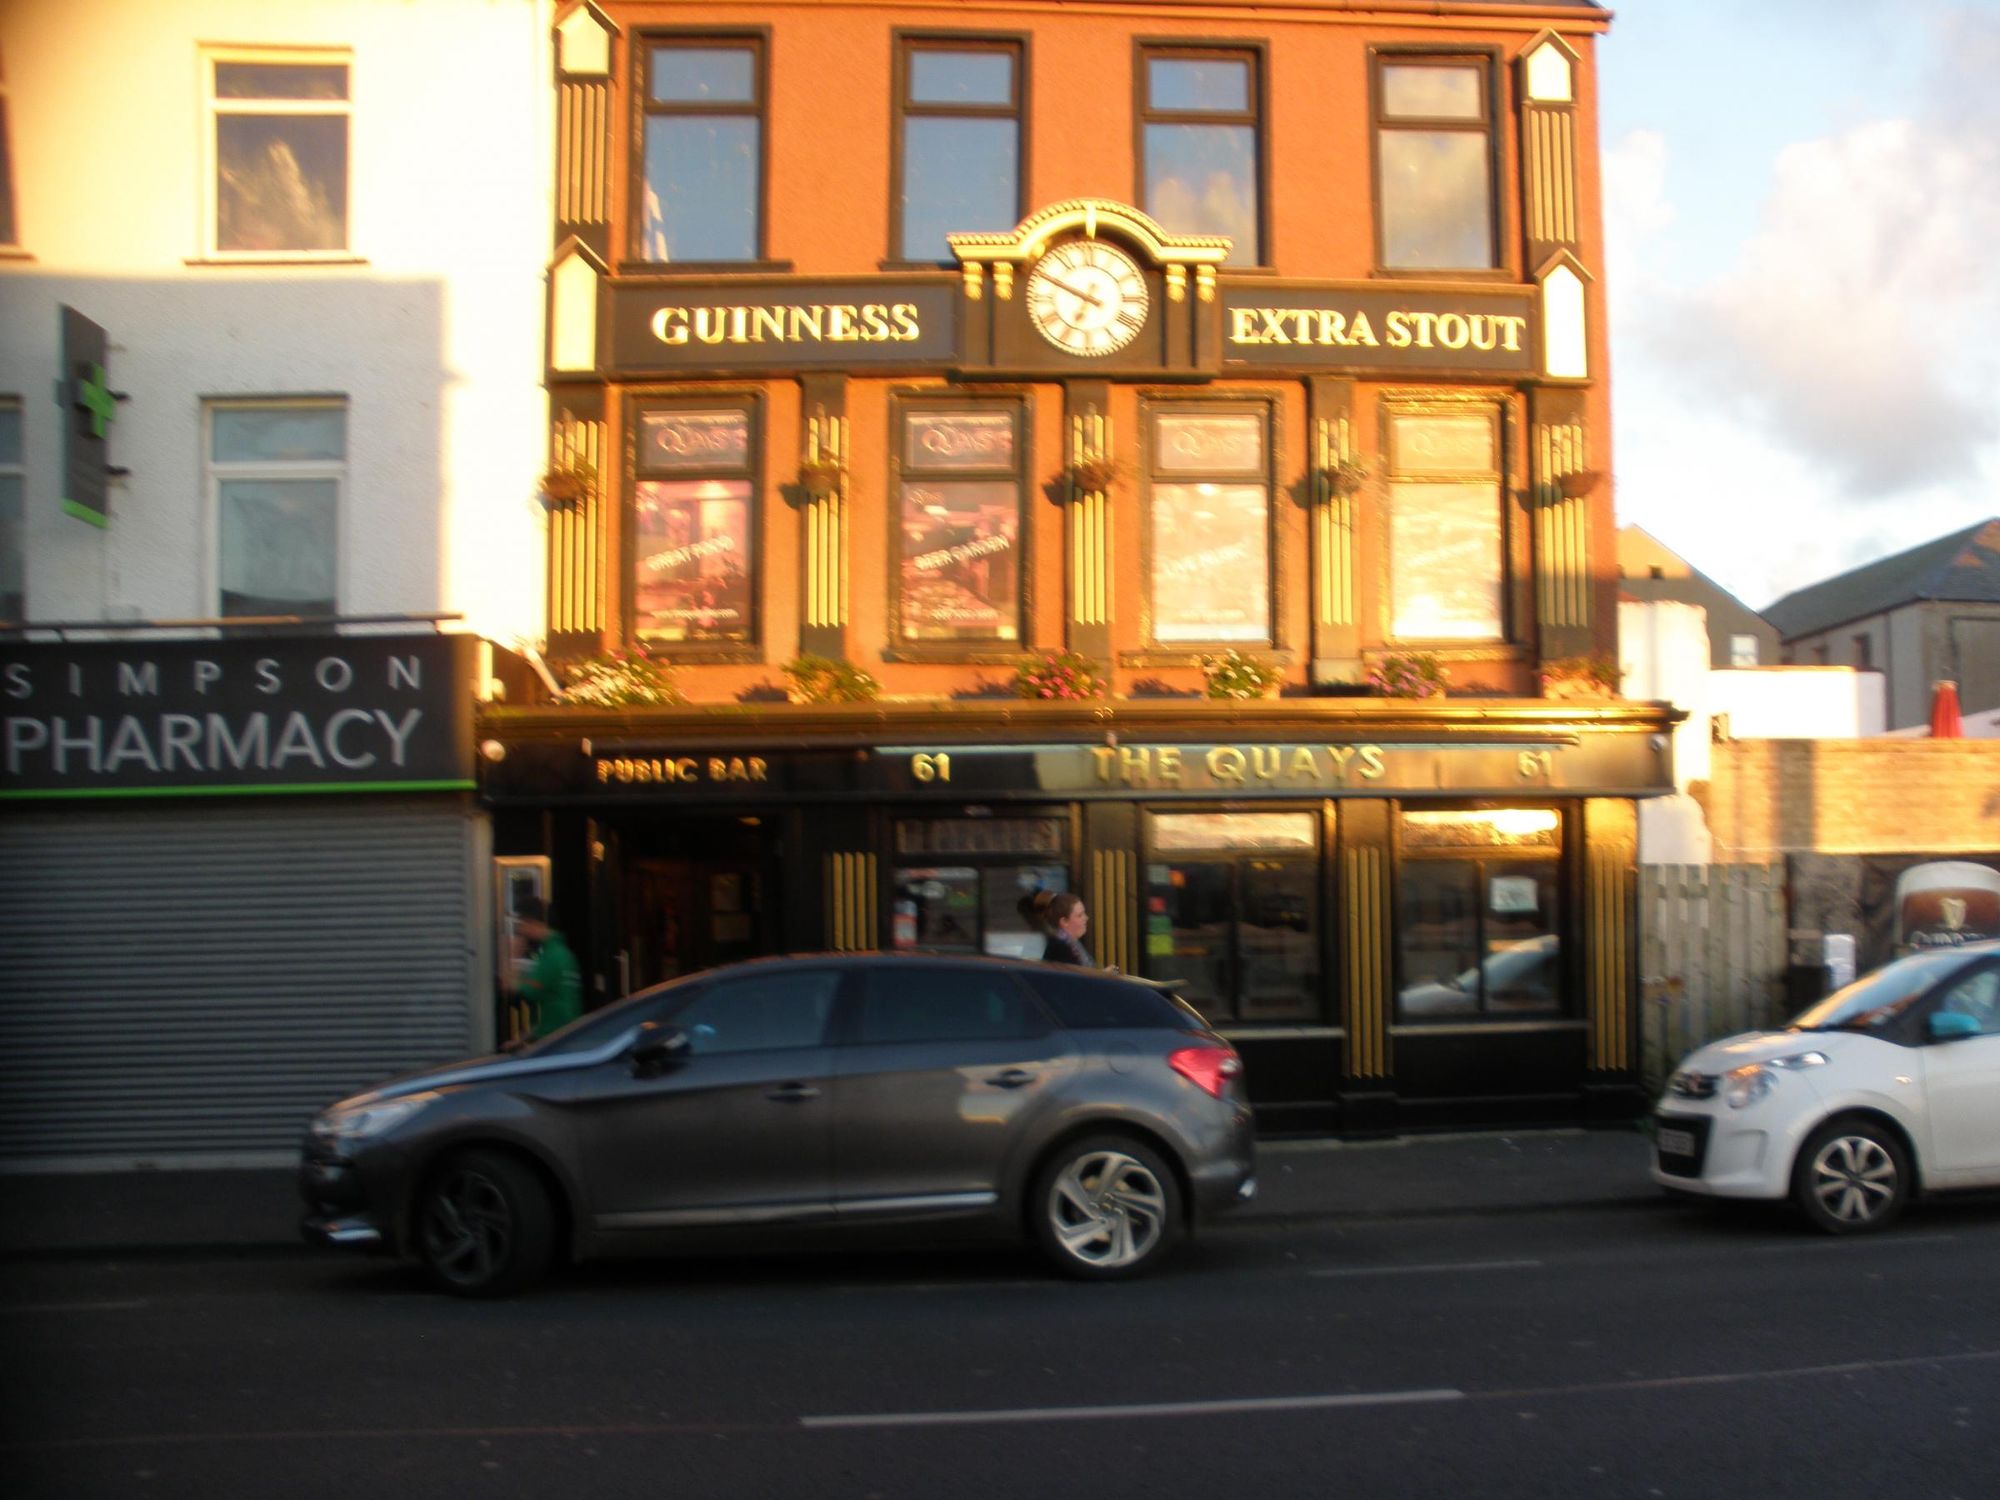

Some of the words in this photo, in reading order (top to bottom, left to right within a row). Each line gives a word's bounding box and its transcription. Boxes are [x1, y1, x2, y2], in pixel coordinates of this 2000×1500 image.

[652, 303, 920, 345] GUINNESS
[1228, 307, 1380, 346] EXTRA
[1386, 311, 1526, 351] STOUT
[5, 655, 422, 698] SIMPSON
[5, 707, 423, 774] PHARMACY
[597, 757, 699, 784] PUBLIC
[708, 756, 767, 783] BAR
[911, 752, 951, 783] 61
[1092, 746, 1182, 782] THE
[1205, 745, 1386, 783] QUAYS
[1518, 750, 1554, 779] 61
